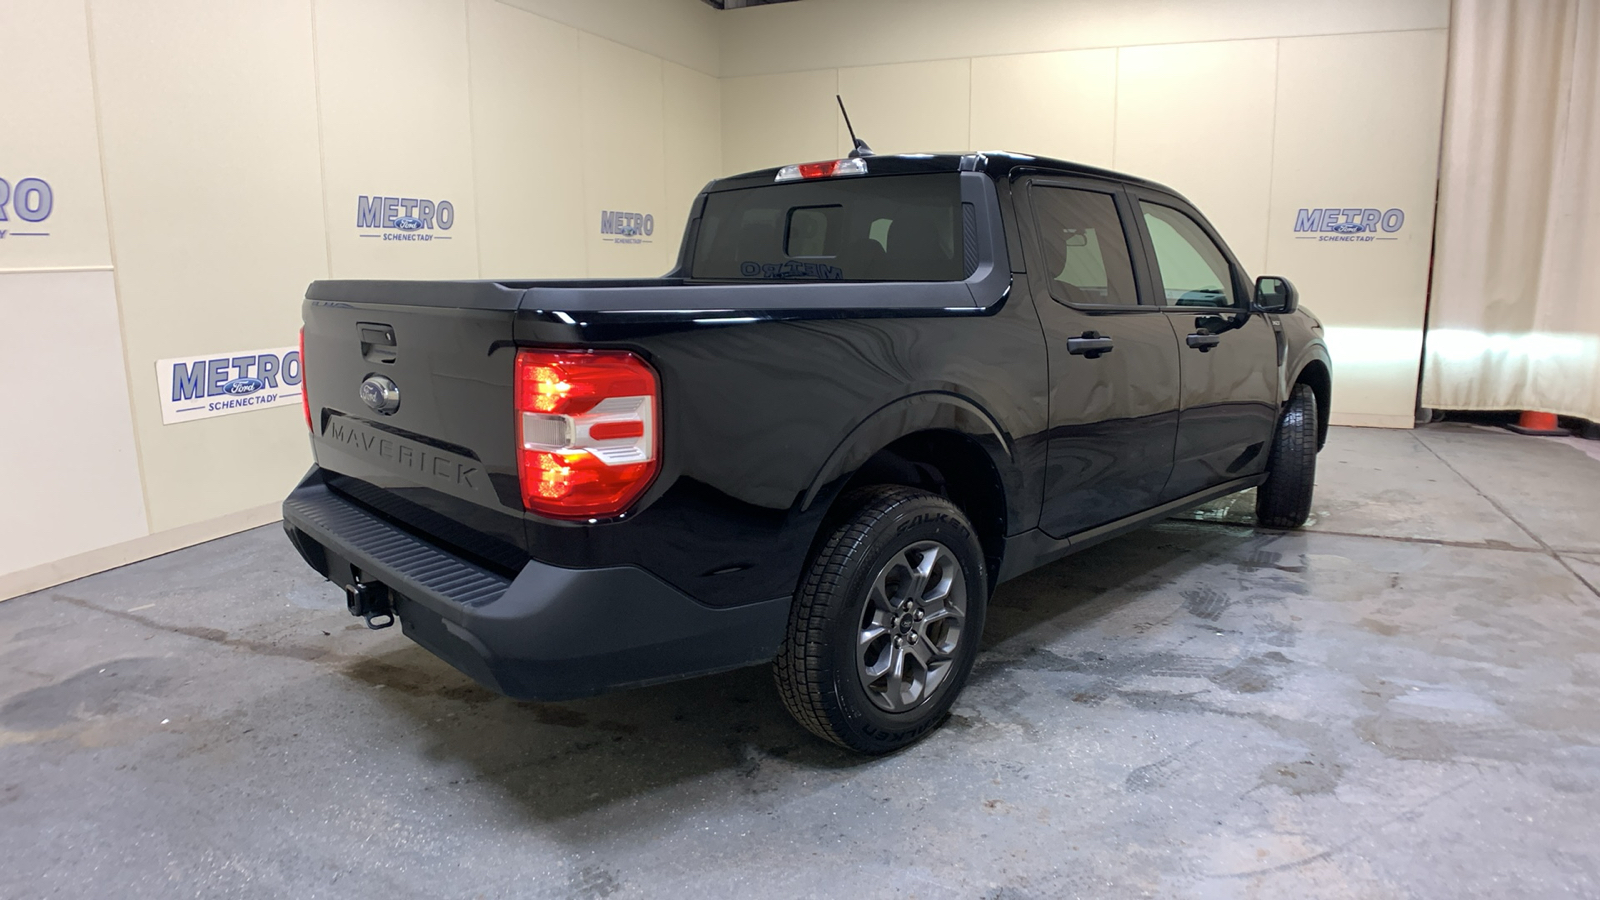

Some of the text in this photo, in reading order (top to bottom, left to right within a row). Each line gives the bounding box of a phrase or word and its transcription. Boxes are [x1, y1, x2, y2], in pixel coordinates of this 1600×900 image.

[357, 196, 454, 230] METRO
[601, 211, 654, 236] METRO
[1294, 208, 1405, 233] METRO
[383, 233, 433, 241] SCHENECTADY
[172, 351, 302, 402] METRO
[231, 380, 255, 393] Ford
[208, 394, 278, 411] SCHENECTADY
[331, 421, 478, 488] MAVERICK
[897, 513, 970, 540] FALKEN
